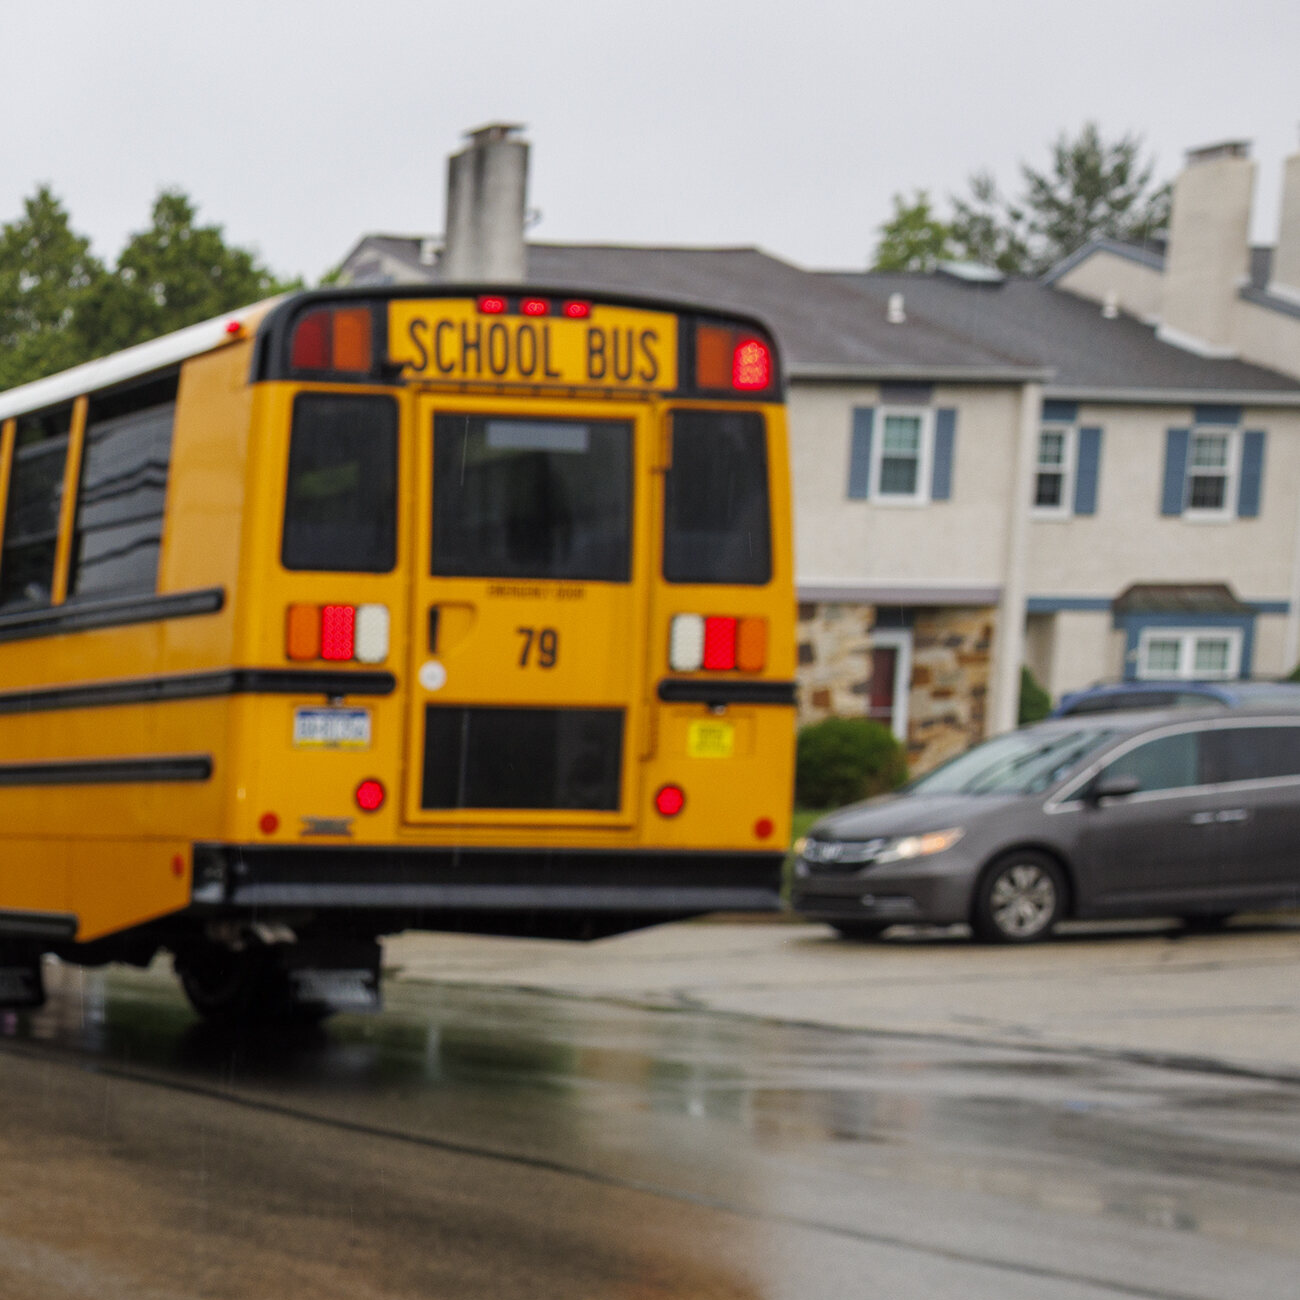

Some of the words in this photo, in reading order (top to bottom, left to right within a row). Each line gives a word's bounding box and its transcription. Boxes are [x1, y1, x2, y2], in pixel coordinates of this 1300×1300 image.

[408, 318, 560, 378] SCHOOL
[587, 327, 659, 382] BUS
[515, 626, 559, 670] 79
